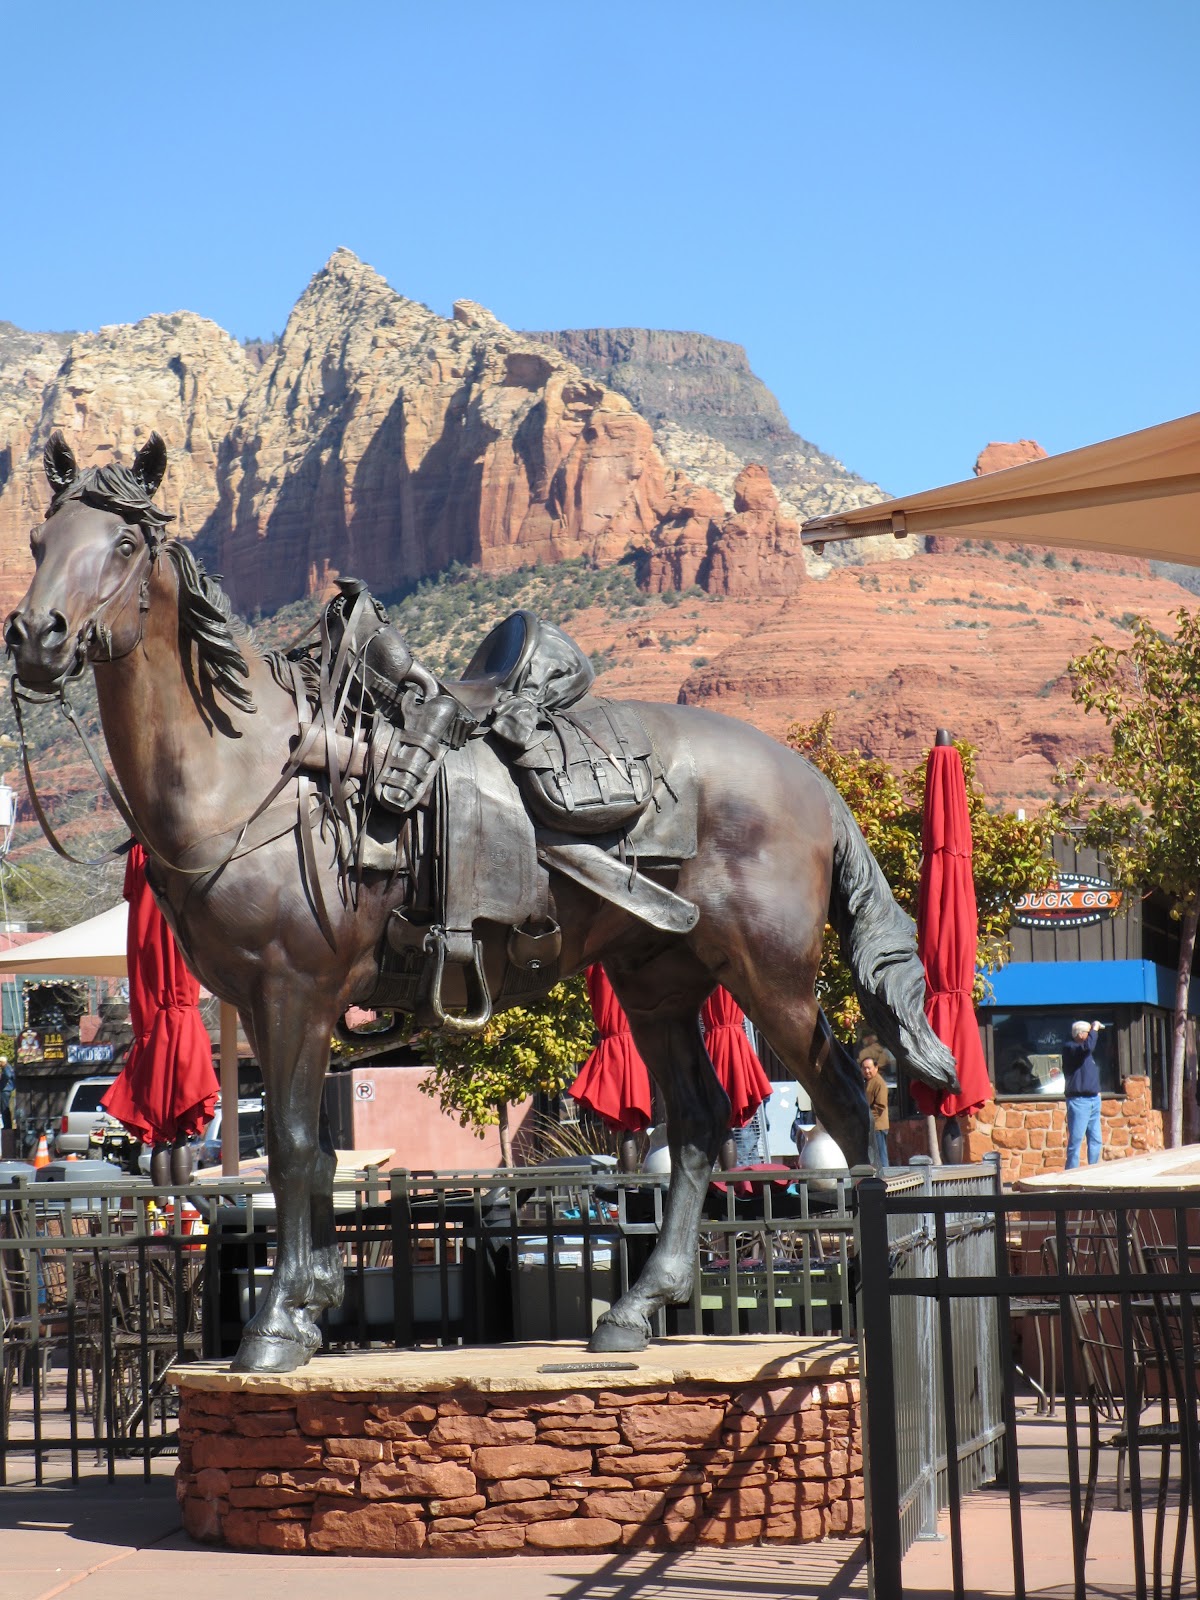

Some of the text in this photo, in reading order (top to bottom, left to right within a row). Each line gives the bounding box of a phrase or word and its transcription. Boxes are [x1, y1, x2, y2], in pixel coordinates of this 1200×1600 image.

[1015, 892, 1073, 908] DUCK
[1018, 913, 1101, 926] EDONA ARIZONA
